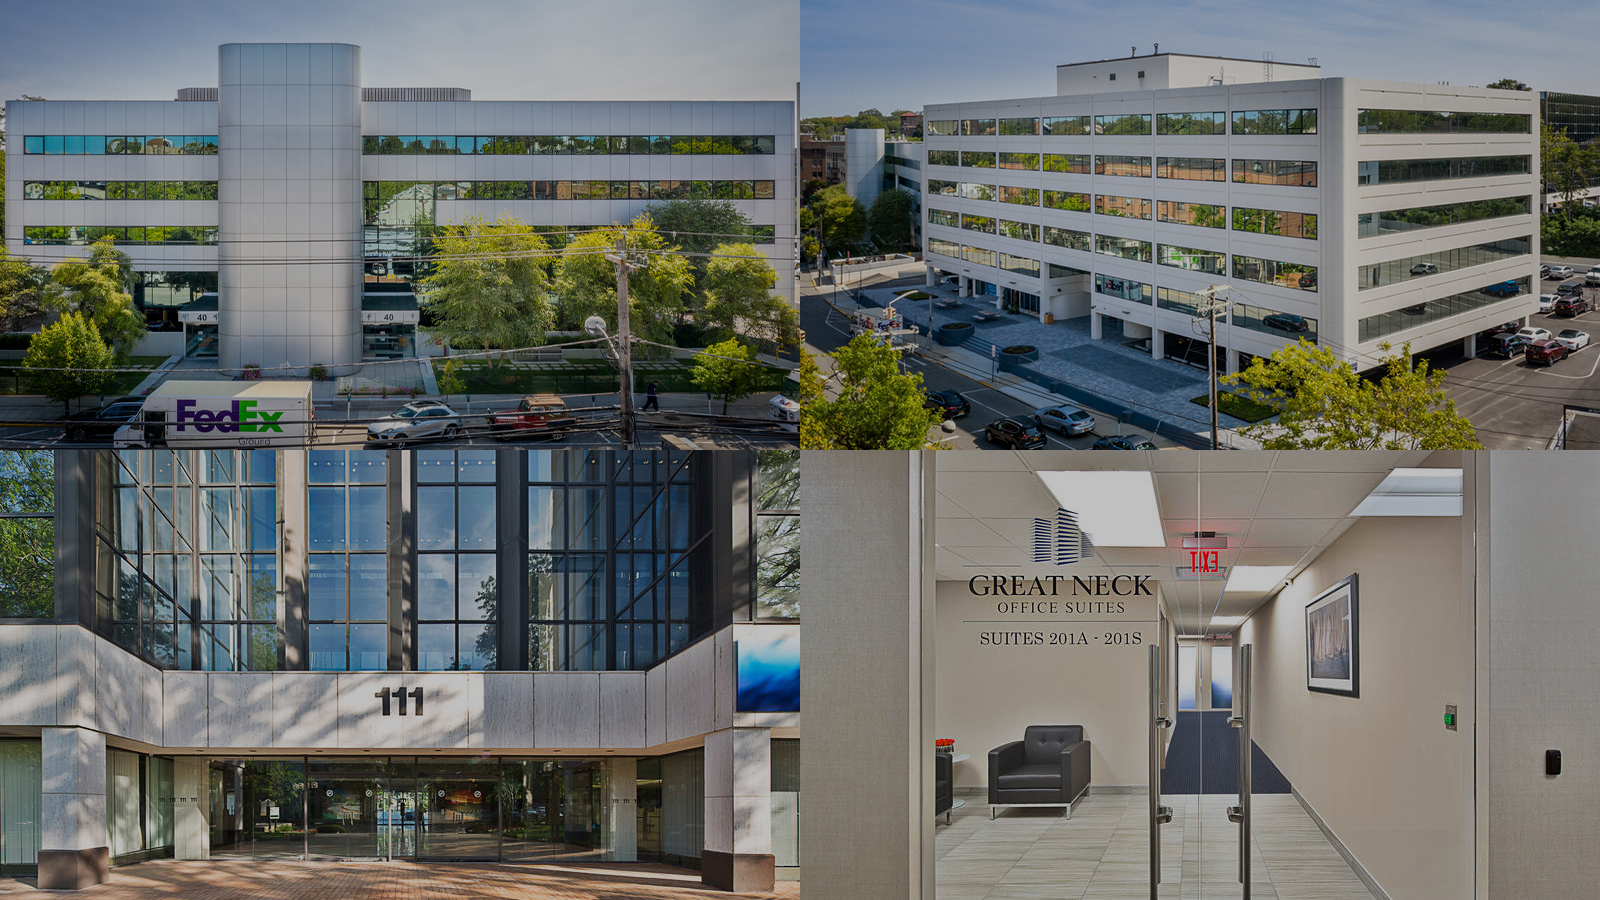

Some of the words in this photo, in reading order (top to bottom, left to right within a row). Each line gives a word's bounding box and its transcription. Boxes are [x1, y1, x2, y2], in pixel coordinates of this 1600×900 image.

[177, 400, 284, 433] FedEx
[239, 438, 270, 446] Ground
[968, 575, 1064, 596] GREAT
[1072, 575, 1152, 596] NECK
[998, 602, 1058, 614] OFFICE
[1066, 602, 1125, 614] SUITES
[980, 632, 1044, 646] SUITES
[1050, 632, 1088, 645] 201A
[1104, 632, 1142, 645] 201S
[375, 687, 424, 716] 111
